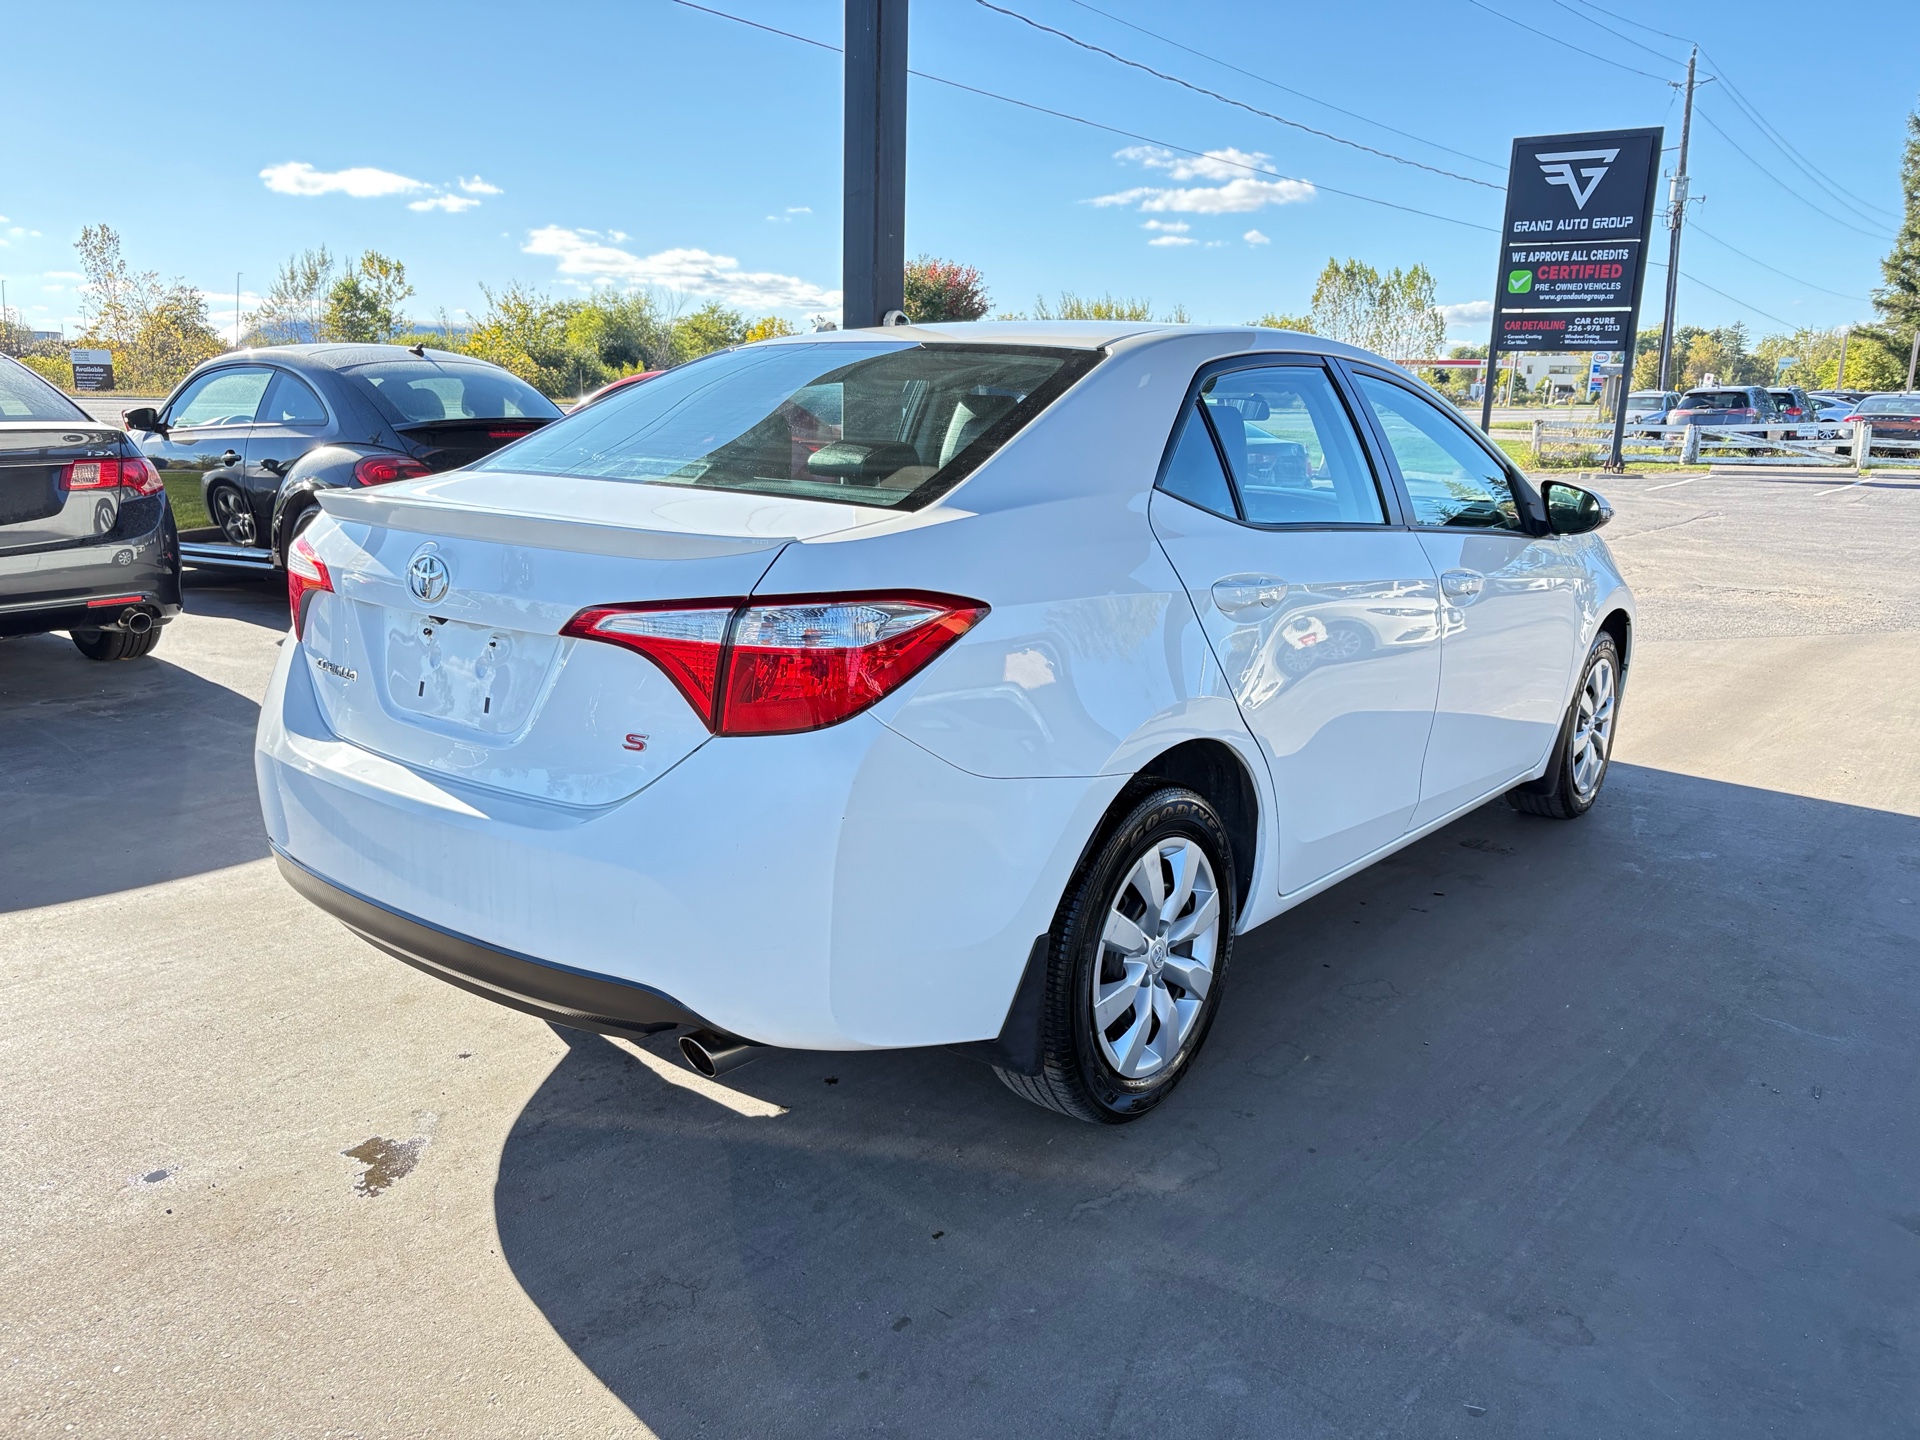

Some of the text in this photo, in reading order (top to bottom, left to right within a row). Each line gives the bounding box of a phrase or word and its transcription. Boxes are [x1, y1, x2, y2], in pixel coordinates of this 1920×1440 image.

[1513, 216, 1634, 233] GRAND AUTO GROUP
[1512, 248, 1629, 263] WE APPROVE ALL CREDITS
[1537, 263, 1623, 280] CERTIFIED
[1555, 283, 1583, 291] OWNED
[1583, 282, 1622, 290] VEHICLES
[1539, 292, 1615, 302] www.grandautogroup.ca
[1504, 320, 1566, 331] CAR DETAILING
[1574, 316, 1615, 325] CAR CURE
[621, 733, 650, 753] S
